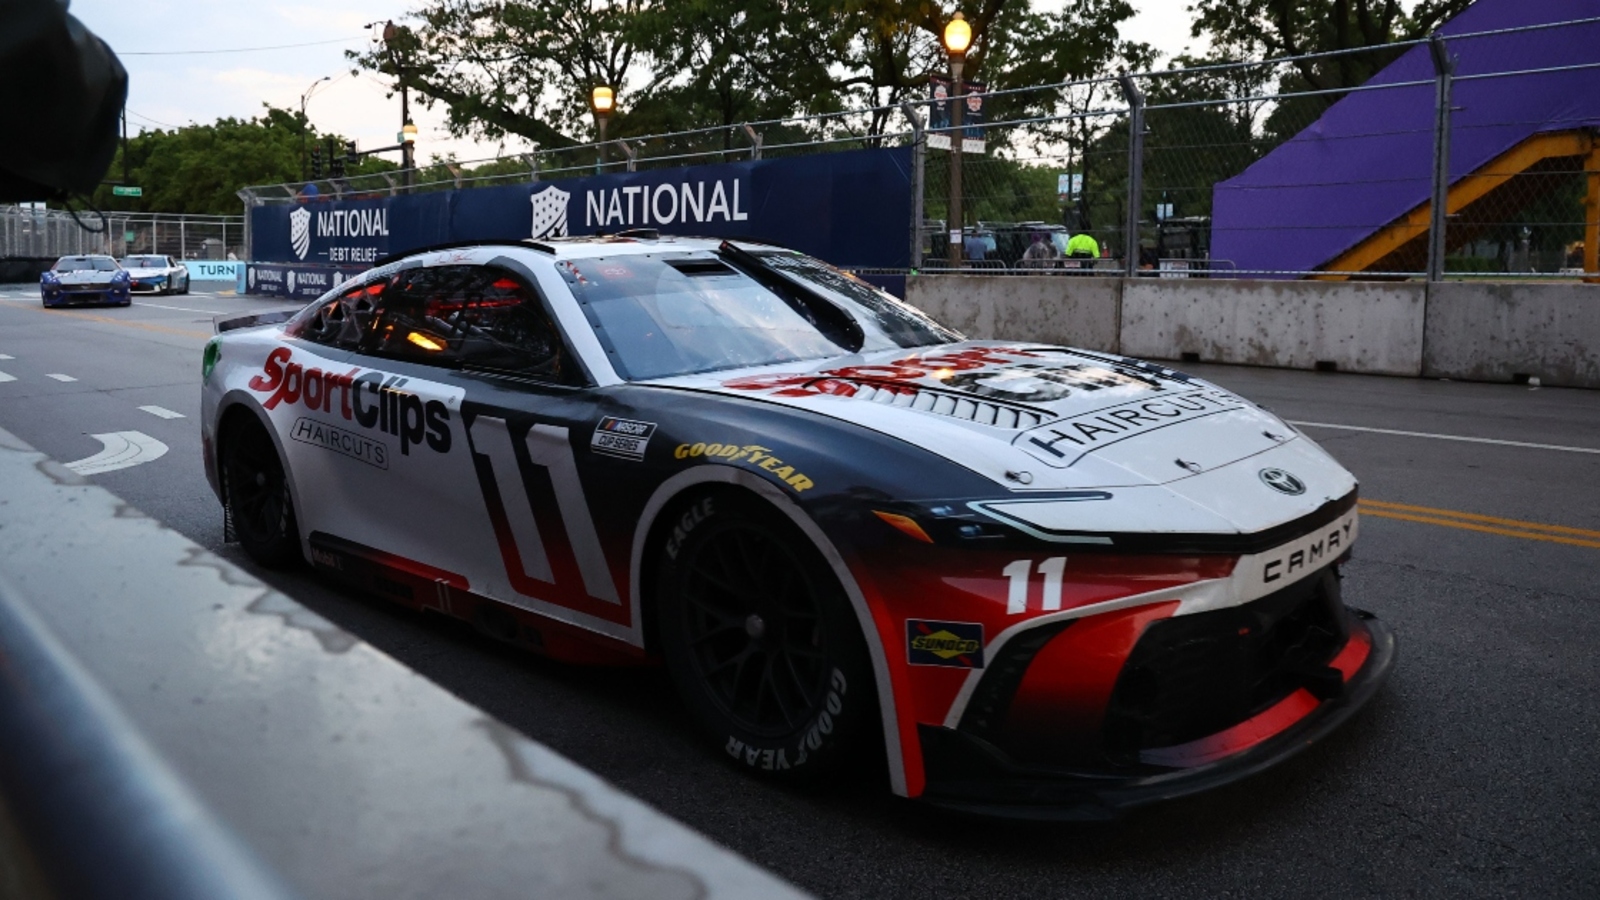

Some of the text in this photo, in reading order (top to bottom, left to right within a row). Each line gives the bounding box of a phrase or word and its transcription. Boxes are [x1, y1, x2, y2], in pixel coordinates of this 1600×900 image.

[586, 178, 748, 227] NATIONAL
[317, 208, 389, 237] NATIONAL
[329, 247, 377, 262] DEBT RELIEF
[198, 265, 236, 276] TURN
[257, 269, 282, 282] NATIONAL
[297, 272, 327, 286] NATIONAL
[613, 420, 648, 435] NASCAR
[297, 421, 385, 464] HAIRCUTS
[598, 434, 640, 451] CUP SERIES
[470, 415, 622, 606] 11
[665, 496, 715, 560] EAGLE
[1263, 518, 1353, 583] CAMRY
[1002, 556, 1068, 615] 11
[915, 637, 979, 652] SUNOCO
